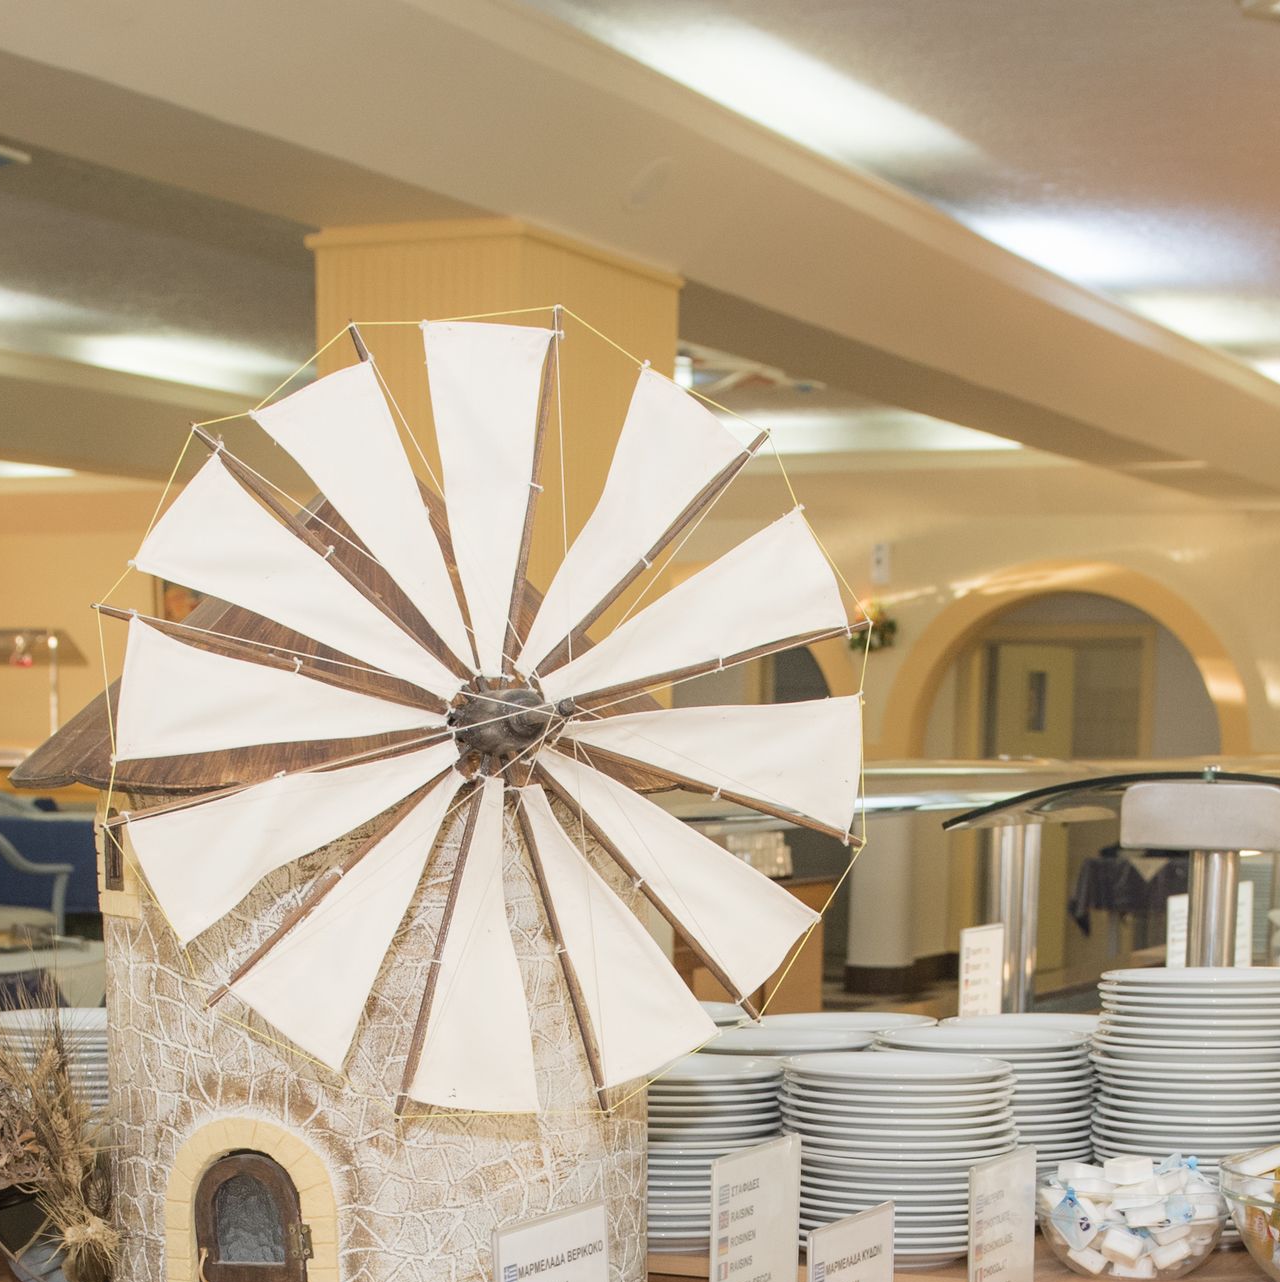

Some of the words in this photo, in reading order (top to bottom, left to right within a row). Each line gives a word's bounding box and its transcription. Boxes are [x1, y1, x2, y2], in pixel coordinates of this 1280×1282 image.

[731, 1205, 754, 1222] RAISINS
[730, 1230, 756, 1246] ROSINEN
[729, 1255, 753, 1272] RAISINS
